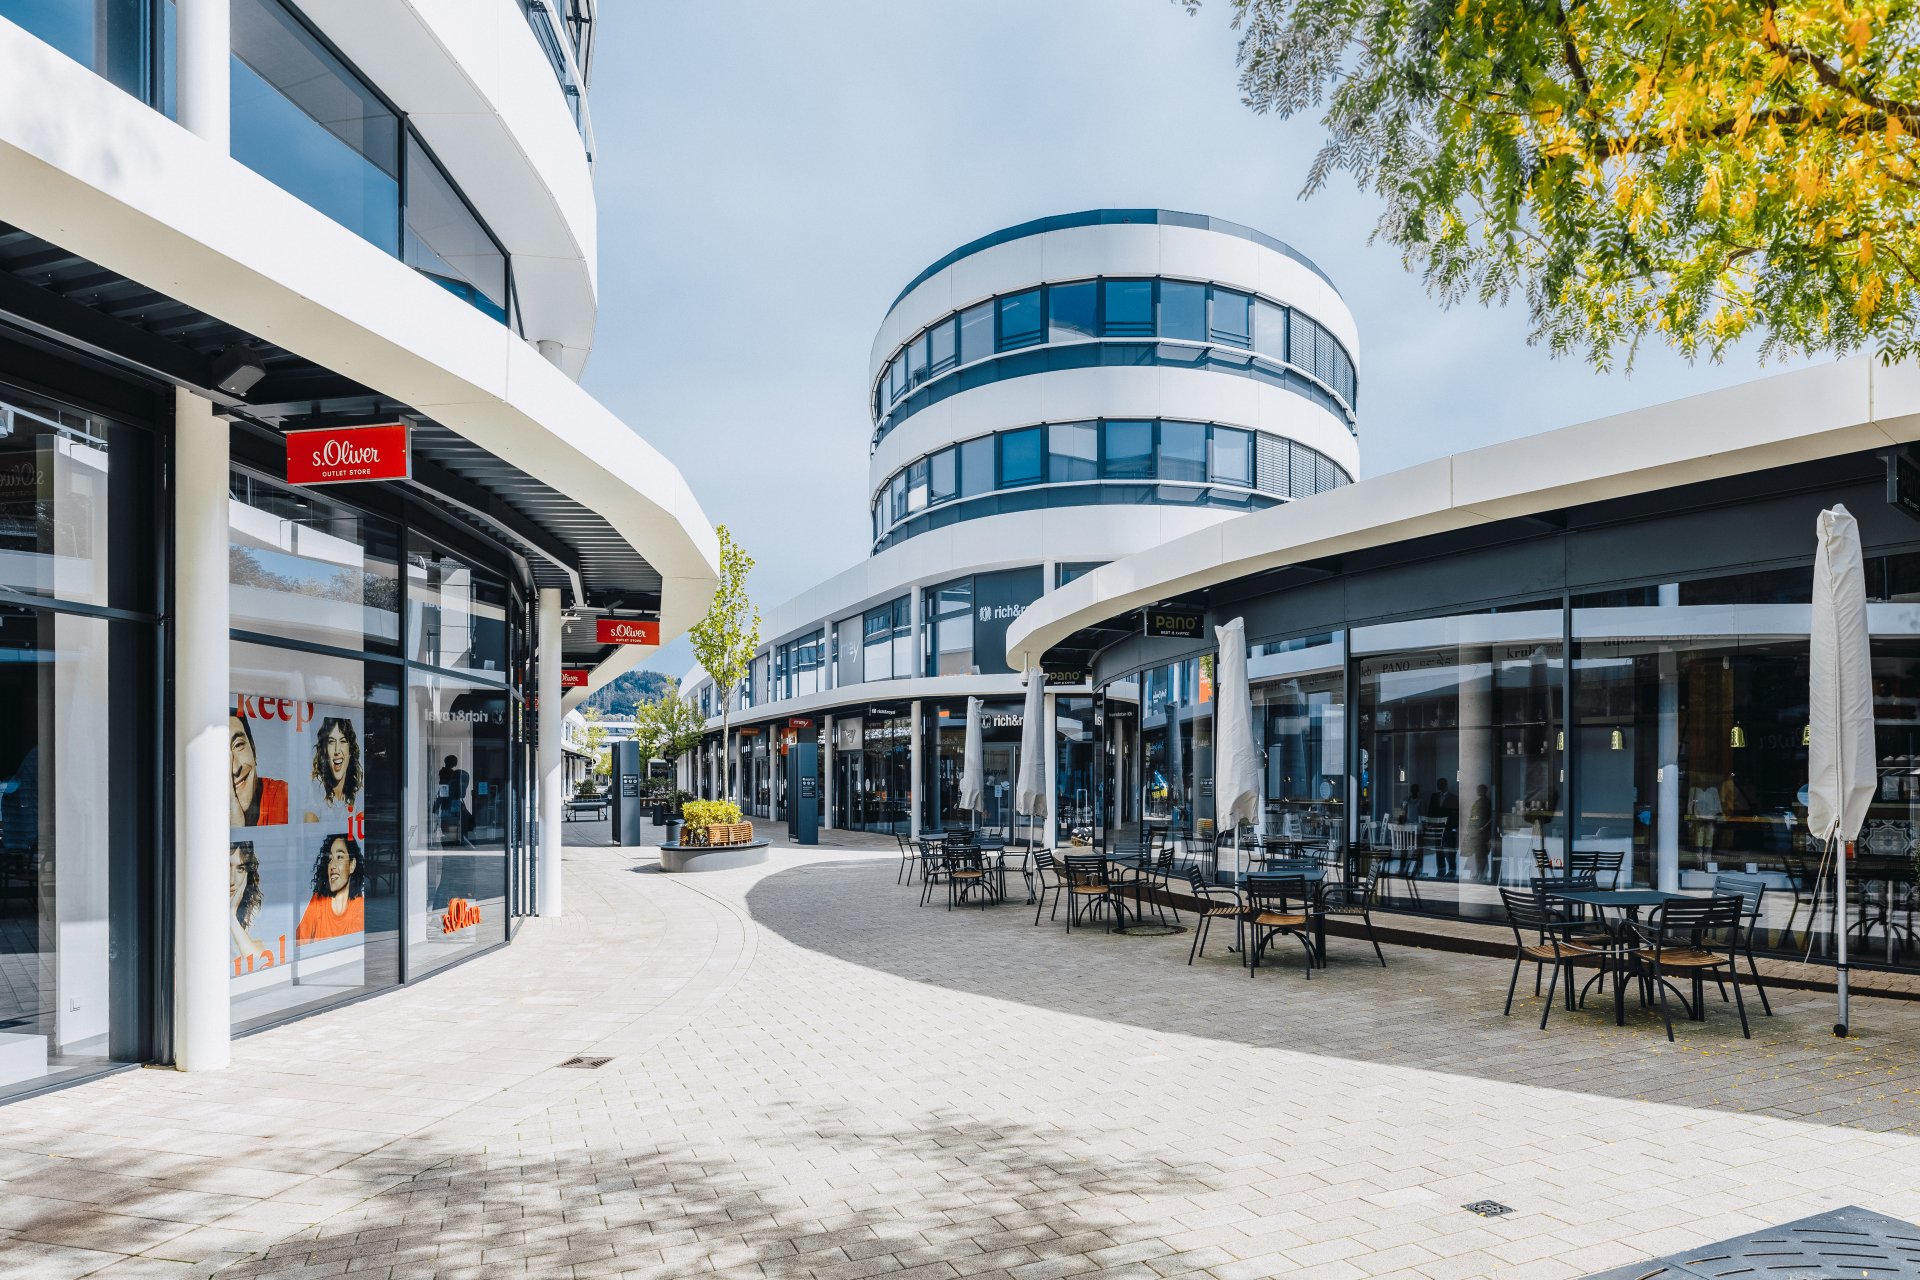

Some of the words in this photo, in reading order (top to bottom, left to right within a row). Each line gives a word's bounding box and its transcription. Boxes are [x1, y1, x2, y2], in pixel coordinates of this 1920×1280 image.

[312, 439, 381, 467] s.Oliver
[610, 624, 647, 638] s.Oliver
[1382, 660, 1411, 673] PANO
